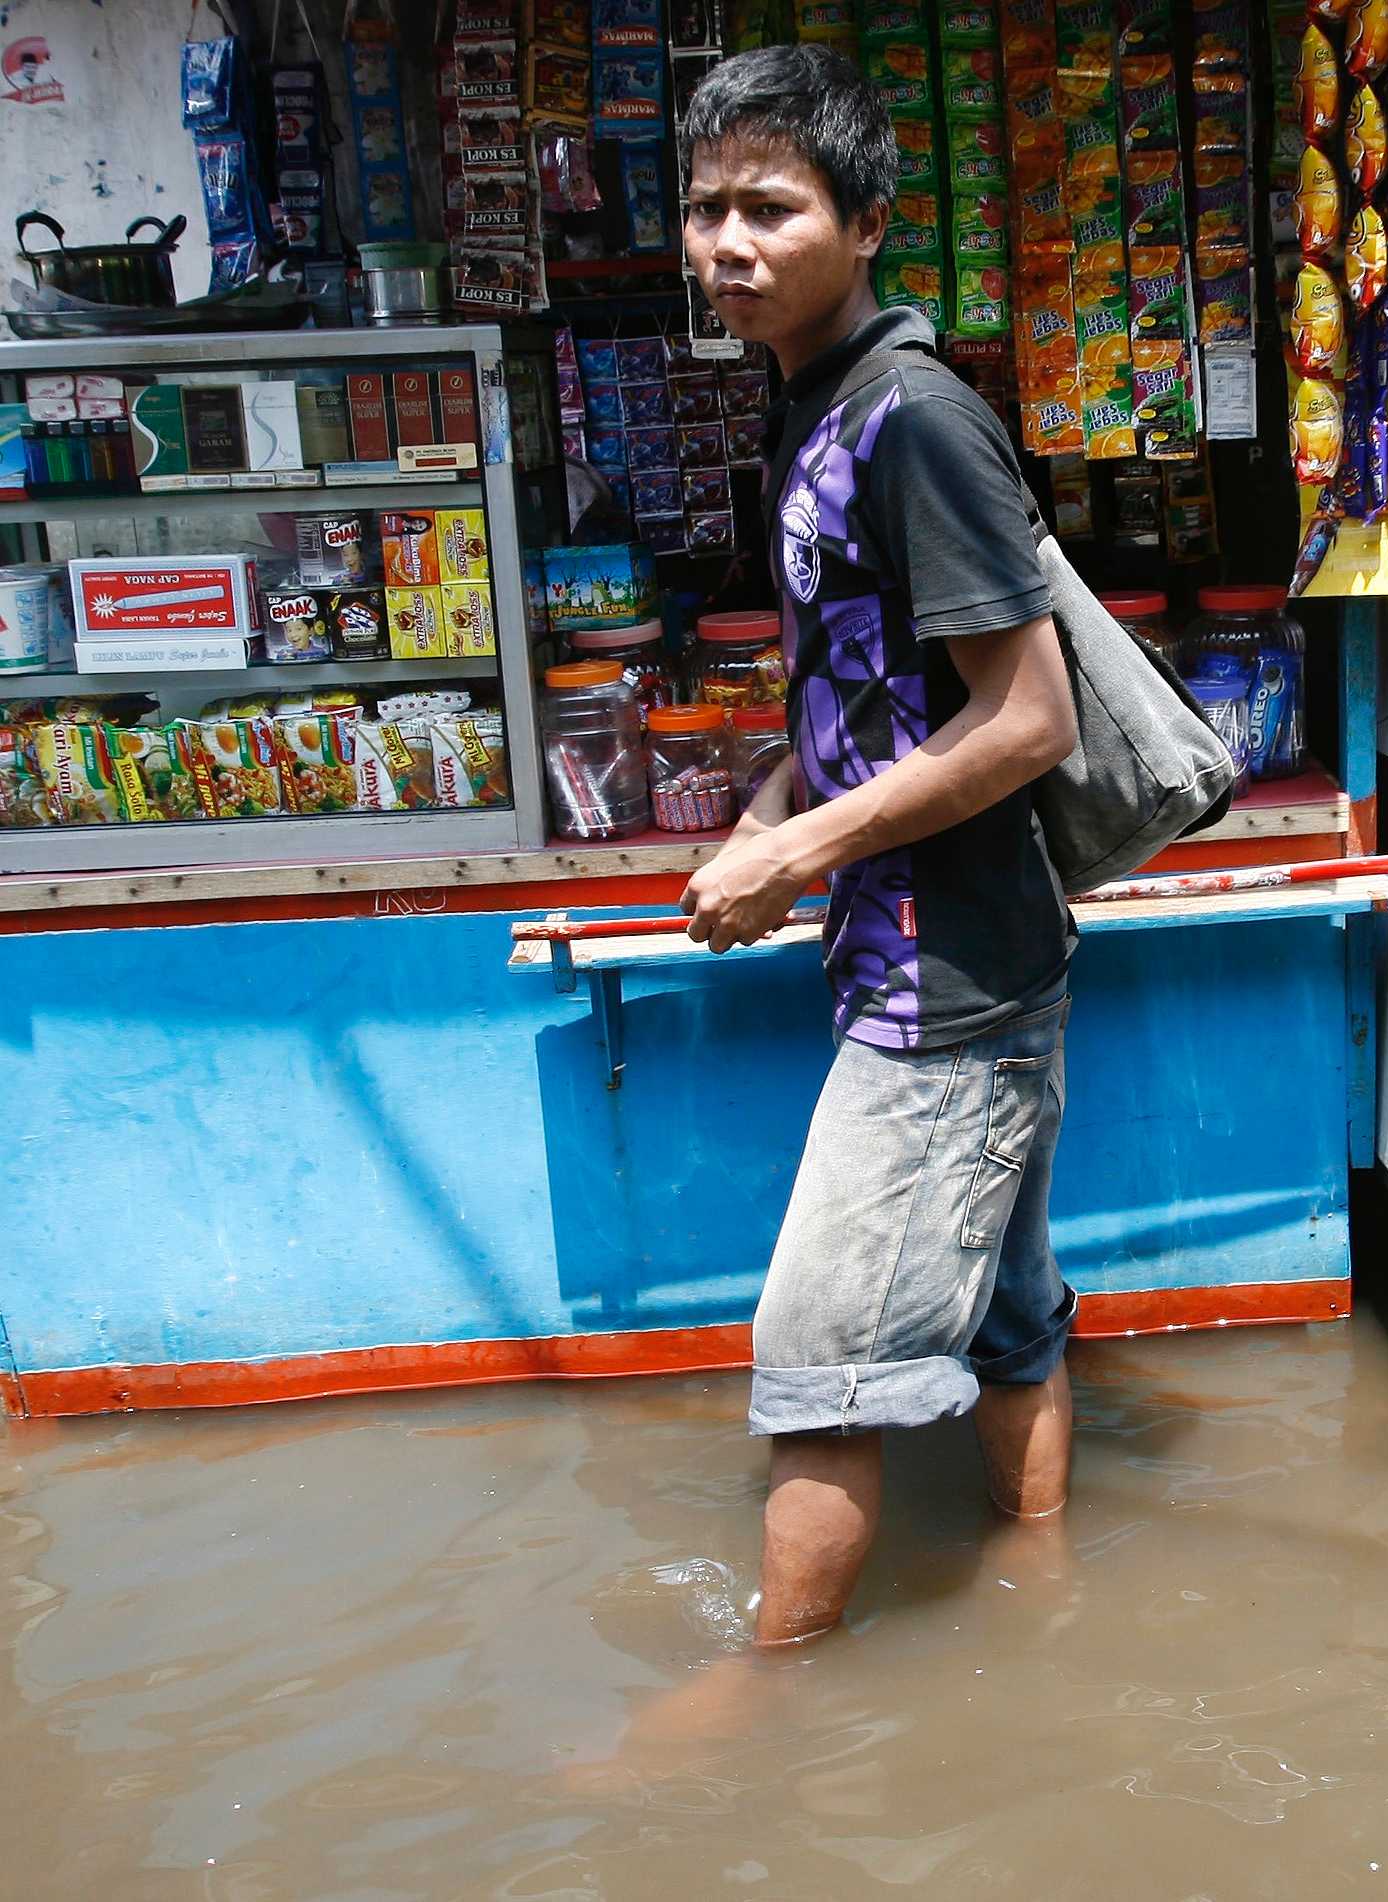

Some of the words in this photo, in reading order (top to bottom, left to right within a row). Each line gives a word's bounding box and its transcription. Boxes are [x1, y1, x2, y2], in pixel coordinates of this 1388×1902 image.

[461, 84, 493, 96] KOPI
[496, 83, 512, 95] ES
[605, 102, 656, 118] MARIMAS
[467, 149, 498, 163] KOPI
[500, 149, 518, 161] ES
[470, 213, 501, 226] KOPI
[503, 212, 519, 224] ES
[1135, 274, 1177, 294] Segar
[460, 286, 494, 300] KOPI
[495, 291, 513, 303] ES
[1145, 285, 1174, 302] Sari
[1032, 309, 1058, 326] Sari
[1084, 308, 1112, 326] Sari
[1031, 317, 1068, 339] Segar
[1083, 317, 1123, 339] Segar
[1136, 367, 1178, 387] Segar
[1146, 379, 1175, 396] Sari
[1039, 401, 1066, 419] Sari
[1089, 401, 1118, 419] Sari
[1039, 410, 1076, 431] Segar
[1089, 410, 1129, 432] Segar
[323, 521, 339, 530] CAP
[124, 575, 157, 585] NAGA
[160, 574, 180, 584] CAP
[199, 610, 228, 622] Super
[272, 599, 317, 619] ENAAK
[1250, 687, 1270, 751] OREO
[54, 753, 72, 794] Ayam
[120, 763, 135, 789] Rasa
[129, 791, 142, 815] Soto
